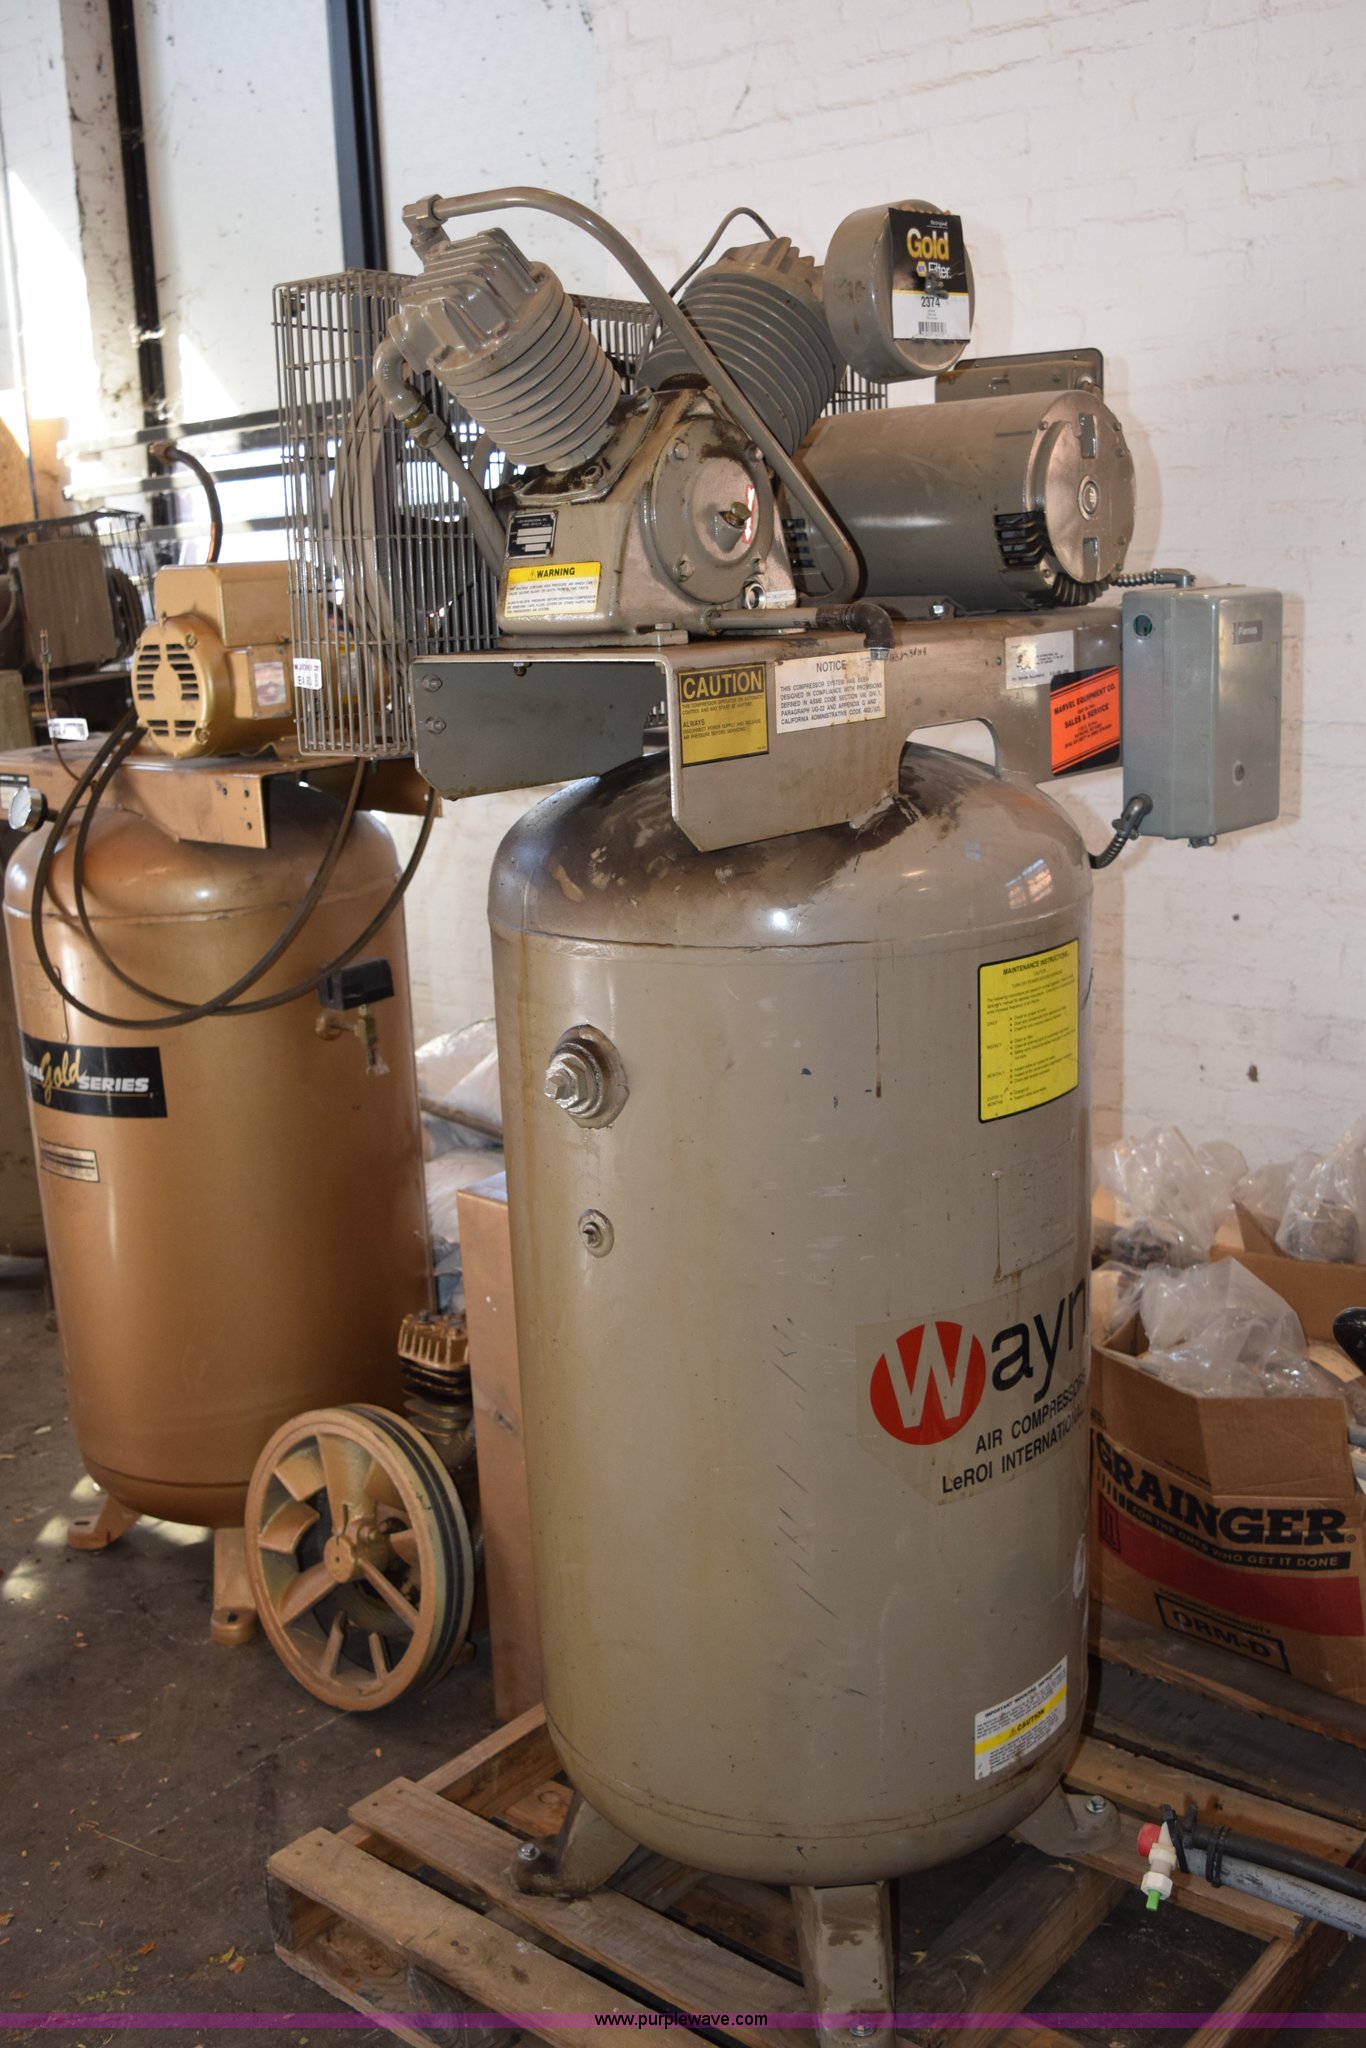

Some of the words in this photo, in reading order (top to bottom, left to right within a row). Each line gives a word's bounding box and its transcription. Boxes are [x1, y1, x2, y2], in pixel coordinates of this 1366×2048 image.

[906, 227, 950, 260] Gold
[920, 296, 941, 308] 2374
[536, 567, 576, 579] WARNING
[816, 660, 847, 673] NOTICE
[683, 671, 762, 700] CAUTION
[781, 692, 804, 700] DESIGNED
[813, 688, 842, 696] COMPLIANCE
[793, 681, 824, 690] COMPRESSOR
[781, 700, 803, 709] DEFINED
[781, 708, 810, 716] PARAGRAPH
[839, 701, 860, 709] APPENDIX
[1054, 699, 1076, 715] MARVEL
[1076, 686, 1107, 705] EQUIPMENT
[683, 718, 705, 728] ALWAYS
[781, 716, 809, 725] CALIFORNIA
[811, 711, 847, 720] ADMINISTRATIVE
[1064, 713, 1082, 729] SALES
[1087, 703, 1110, 719] SERVICE
[1003, 960, 1040, 976] MAINTENANCE
[1040, 950, 1069, 966] INSTRUCTIONS
[40, 1048, 81, 1105] Gold
[78, 1075, 149, 1093] SERIES
[942, 1460, 993, 1494] LeROI
[1001, 1402, 1085, 1474] INTERNATIONAL
[975, 1428, 1003, 1454] AIR
[1131, 1505, 1152, 1522] FOR
[1155, 1517, 1175, 1536] THE
[1178, 1528, 1208, 1552] ONES
[1211, 1549, 1244, 1563] WHO
[1247, 1554, 1276, 1565] GET
[1279, 1555, 1293, 1566] IT
[1296, 1555, 1339, 1568] DONE
[1172, 1609, 1272, 1658] ORM-D
[984, 1701, 1013, 1718] IMPORTANT
[1016, 1707, 1045, 1731] CAUTION
